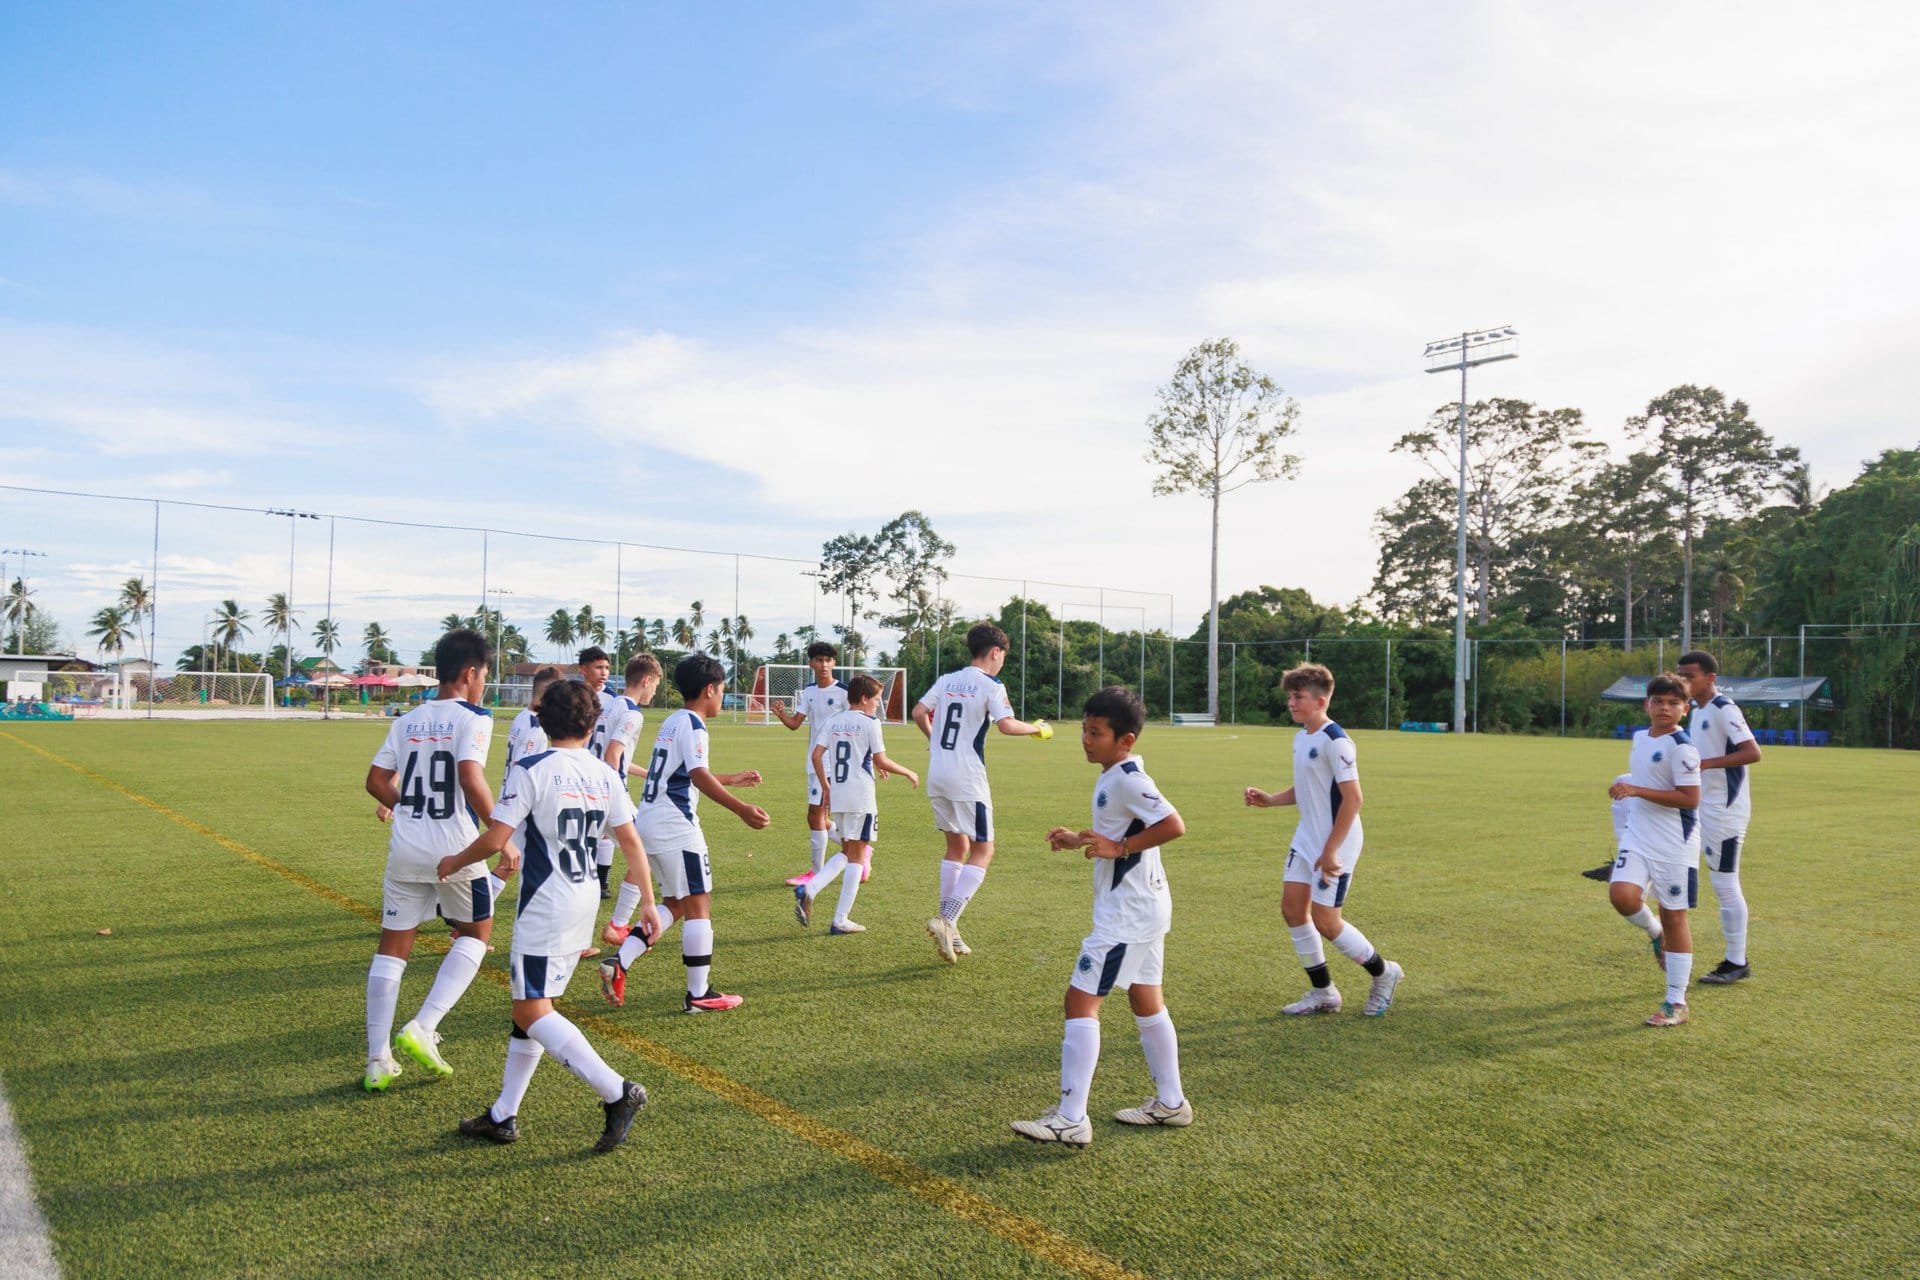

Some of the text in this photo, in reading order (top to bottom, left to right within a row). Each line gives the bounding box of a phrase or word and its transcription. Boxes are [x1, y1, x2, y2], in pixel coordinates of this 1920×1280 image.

[940, 702, 963, 751] 6
[400, 750, 456, 819] 49
[835, 740, 851, 783] 8
